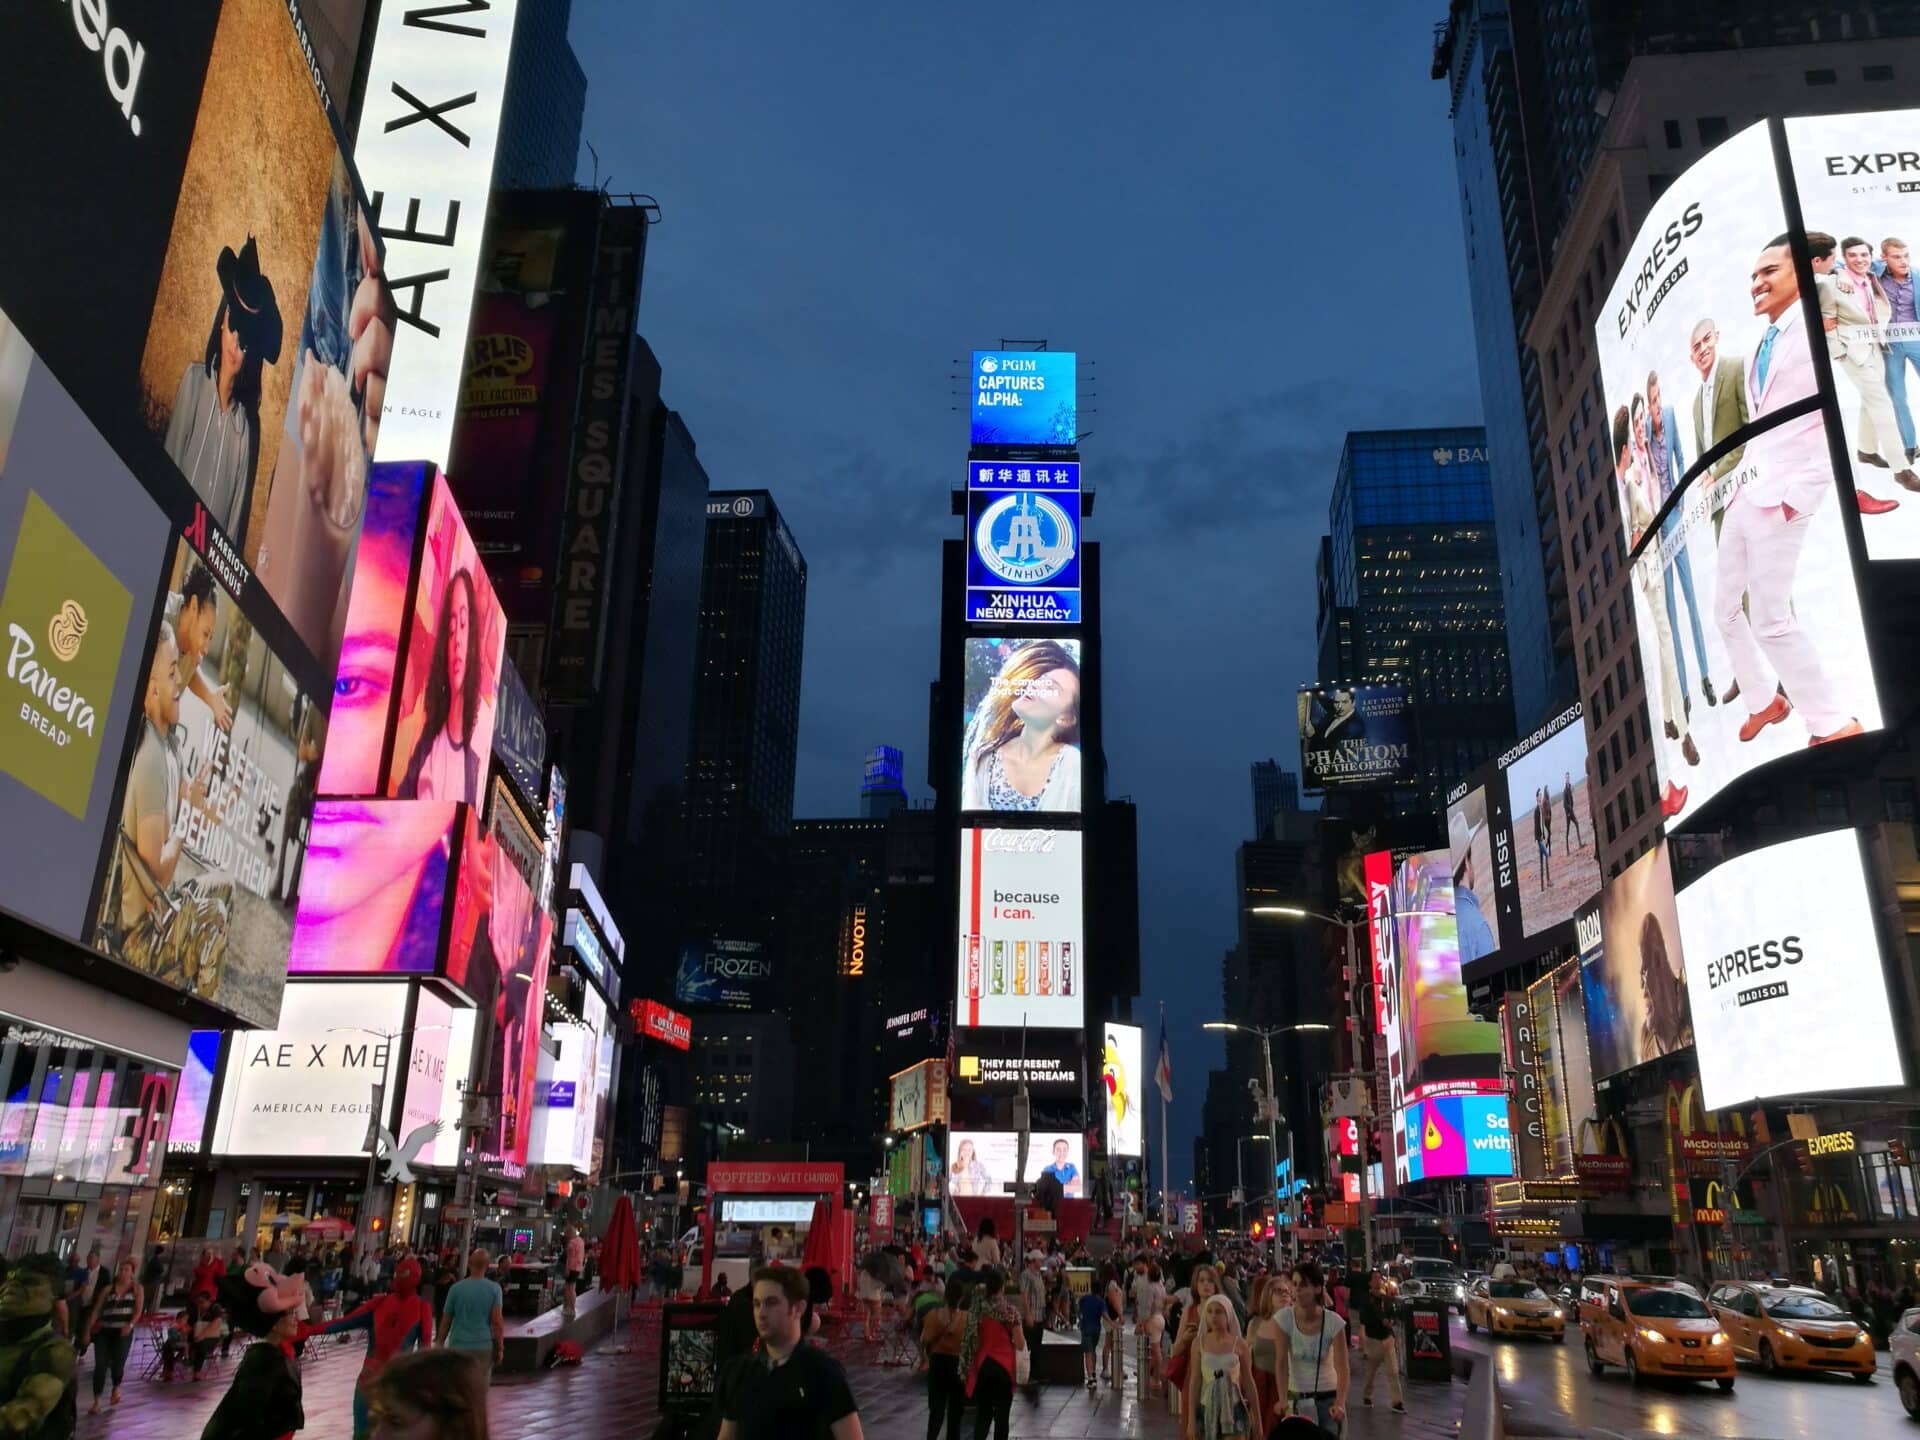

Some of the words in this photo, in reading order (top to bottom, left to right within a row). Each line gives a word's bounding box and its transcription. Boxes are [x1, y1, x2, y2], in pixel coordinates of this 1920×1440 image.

[384, 81, 477, 149] X
[1825, 152, 1920, 177] EXPR
[1618, 202, 1703, 340] EXPRESS
[1648, 259, 1688, 321] MADISON
[592, 246, 633, 400] TIMES
[1002, 360, 1036, 371] PGIM
[978, 375, 1045, 390] CAPTURES
[978, 392, 1023, 406] ALPHA:
[401, 406, 442, 419] EAGLE
[978, 468, 1069, 484] 新华通讯社
[563, 419, 613, 629] SQUARE
[211, 527, 249, 583] MARRIOTT
[208, 546, 242, 596] MARQUIS
[998, 563, 1055, 580] XINHUA
[991, 594, 1056, 608] XINHUA
[976, 607, 1014, 619] NEWS
[1016, 608, 1071, 620] AGENCY
[7, 622, 97, 738] Panera
[1011, 677, 1053, 687] camera
[1014, 687, 1060, 699] changes
[1341, 738, 1368, 749] THE
[1497, 738, 1530, 770] DISCOVER
[1529, 725, 1547, 747] NEW
[1546, 706, 1576, 737] ARTISTS
[1304, 743, 1409, 768] PHANTOM
[226, 743, 253, 796] SEE
[1313, 764, 1330, 775] OF
[1331, 762, 1358, 773] THE
[1358, 759, 1401, 771] OPERA
[1446, 782, 1468, 804] LANCO
[208, 774, 260, 848] PEOPLE
[175, 798, 233, 868] BEHIND
[233, 848, 273, 899] THEM
[1496, 828, 1512, 889] RISE
[993, 889, 1060, 904] because
[993, 906, 998, 919] I
[1002, 907, 1036, 919] can.
[704, 953, 772, 978] FROZEN
[1707, 935, 1804, 990] EXPRESS
[1739, 983, 1788, 1004] MADISON
[910, 1008, 927, 1022] LOPEZ
[250, 1044, 294, 1068] AE
[307, 1044, 328, 1068] X
[342, 1044, 388, 1068] ME
[411, 1047, 425, 1073] AE
[425, 1053, 433, 1078] X
[432, 1056, 444, 1083] ME
[980, 1059, 1004, 1069] THEY
[984, 1071, 1019, 1081] HOPES
[1030, 1071, 1075, 1081] DREAMS
[1516, 1003, 1541, 1137] PALACE
[252, 1103, 324, 1114] AMERICAN
[331, 1103, 372, 1114] EAGLE
[1683, 1139, 1749, 1151] McDonald's
[1807, 1131, 1855, 1156] EXPRESS
[712, 1171, 771, 1184] COFFEED
